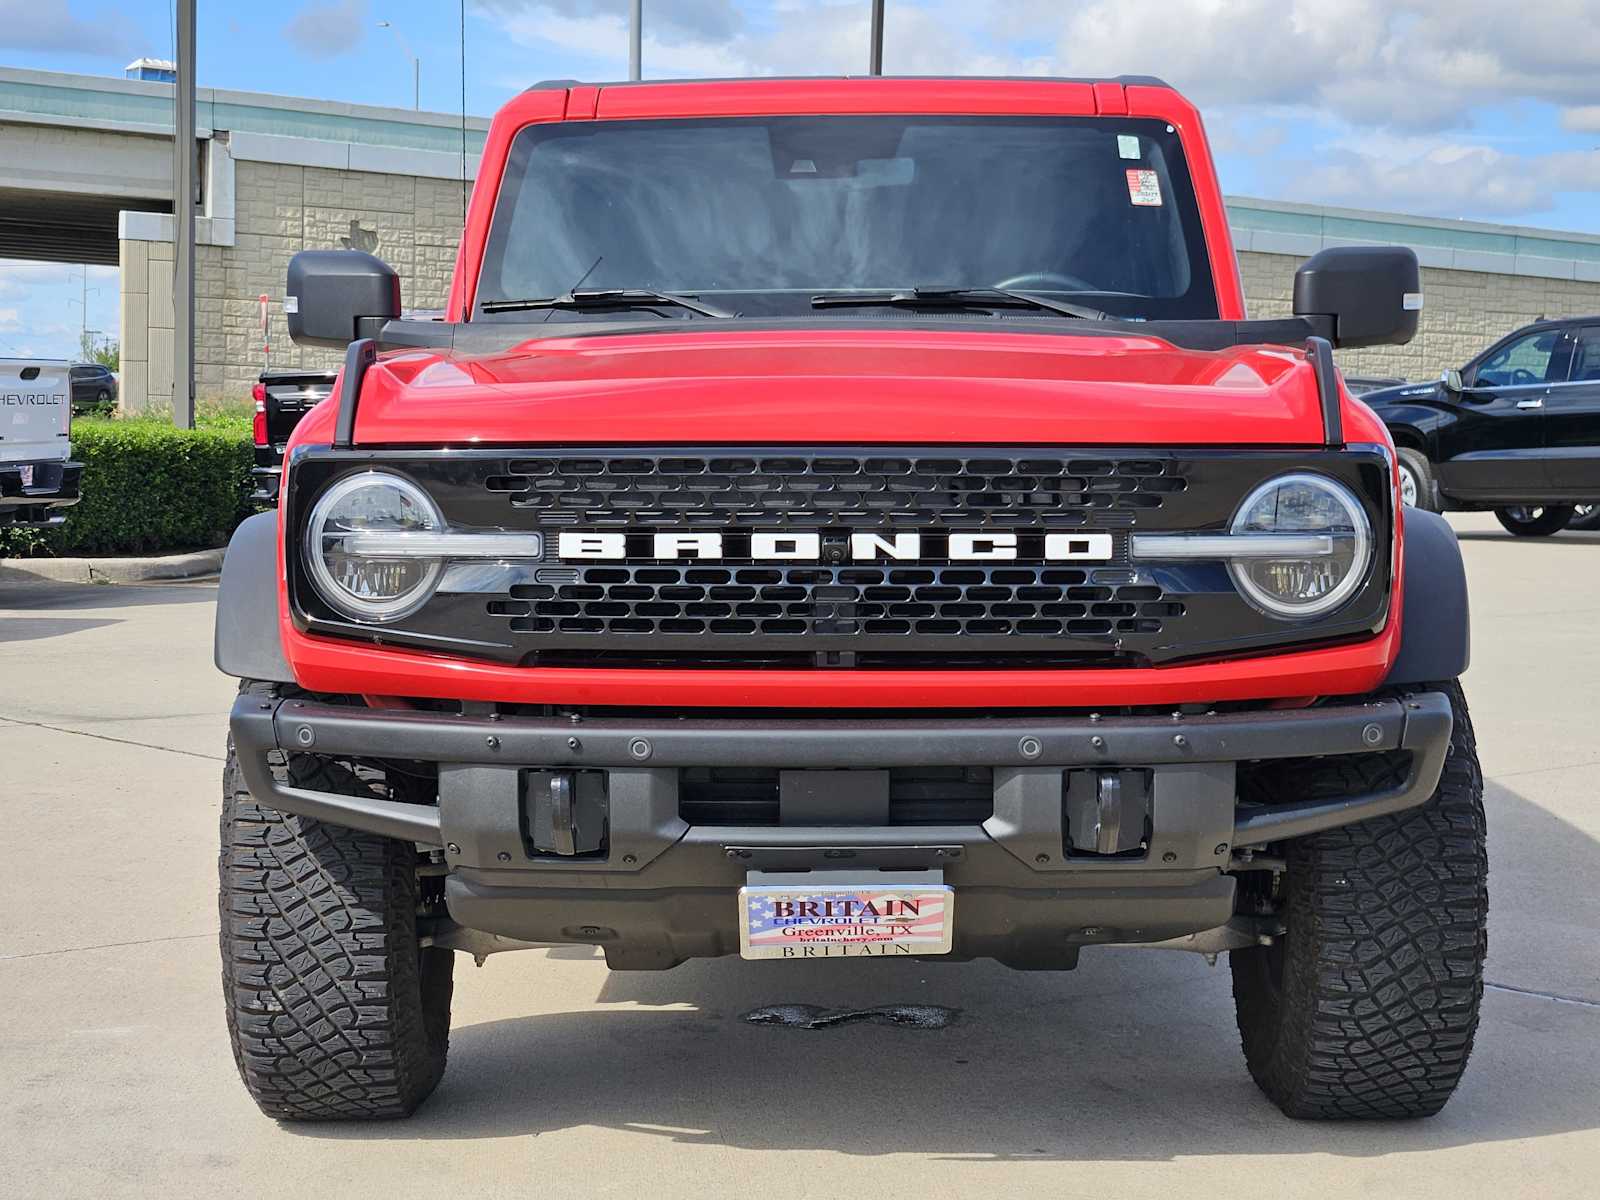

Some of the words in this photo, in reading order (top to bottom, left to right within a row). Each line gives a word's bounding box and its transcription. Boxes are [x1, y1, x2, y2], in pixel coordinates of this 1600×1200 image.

[559, 533, 1112, 560] BRONCO
[773, 900, 920, 917] BRITAIN
[773, 917, 880, 925] CHEVROLET
[782, 926, 880, 936] Greenville,
[886, 925, 913, 935] TX
[783, 943, 910, 957] BRITAIN
